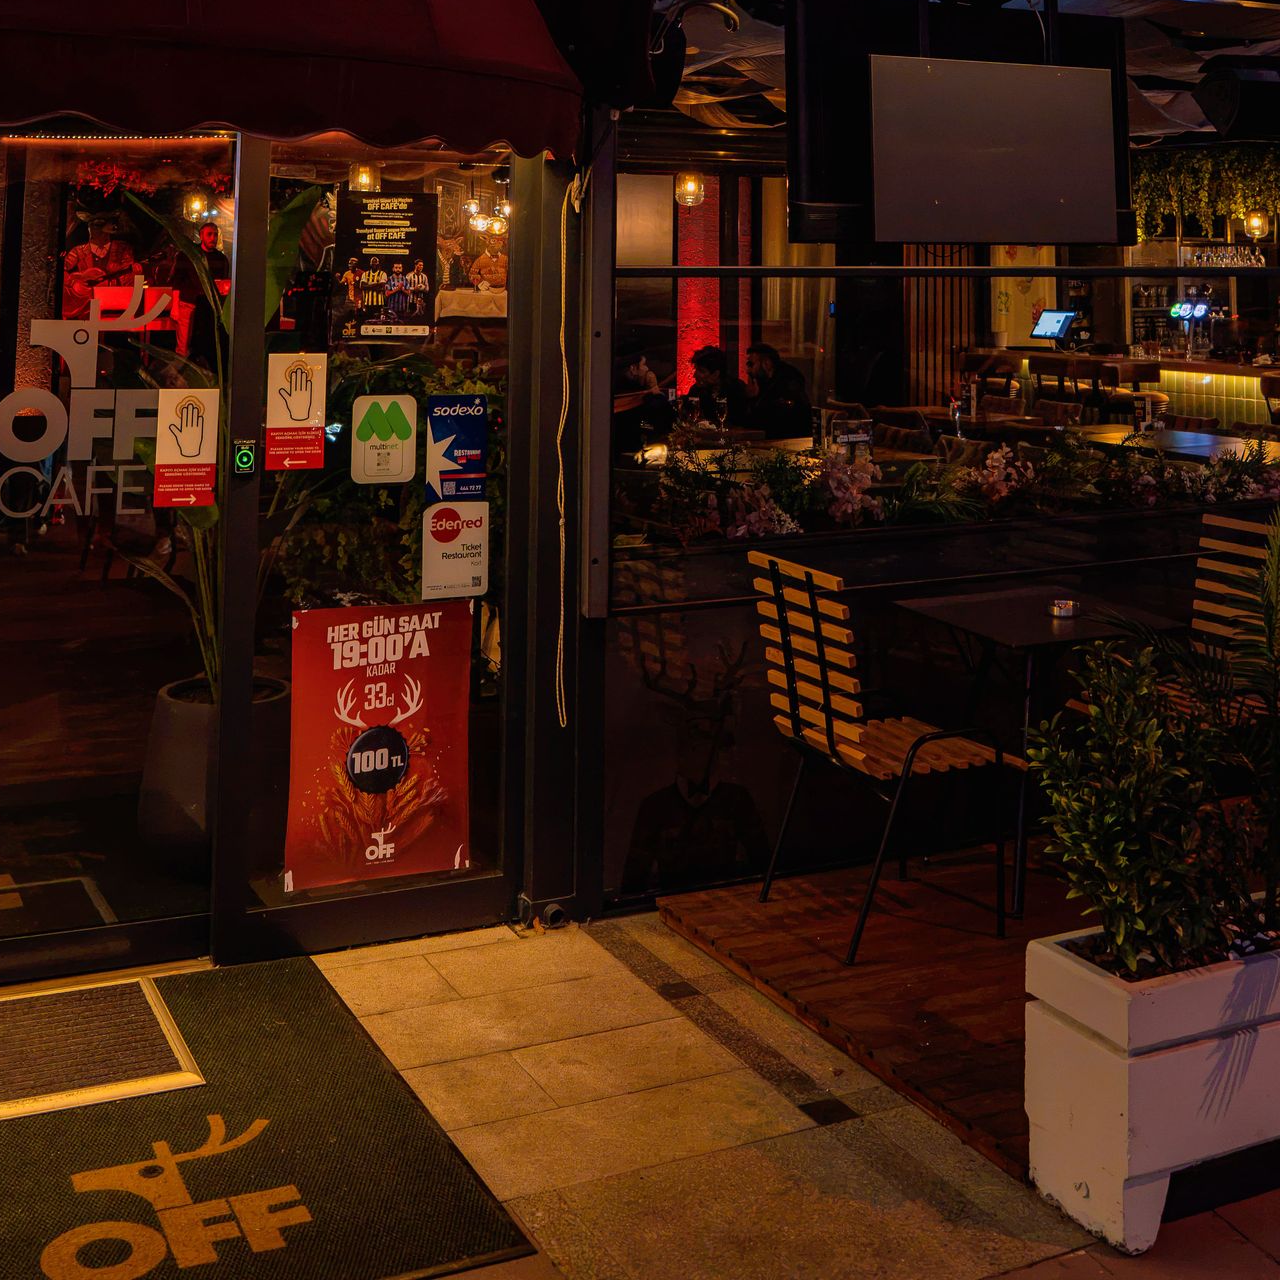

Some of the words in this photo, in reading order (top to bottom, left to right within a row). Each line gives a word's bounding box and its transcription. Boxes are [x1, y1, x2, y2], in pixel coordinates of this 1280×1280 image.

[388, 231, 406, 239] CAFE
[432, 404, 484, 416] sodexo
[369, 443, 399, 451] multinet
[430, 517, 483, 531] Edenred
[461, 543, 482, 551] Ticket
[442, 551, 482, 560] Restaurant
[327, 622, 359, 644] HER
[362, 615, 396, 638] GÜN
[399, 612, 442, 631] SAAT
[366, 662, 396, 677] KADAR
[351, 748, 389, 774] 100
[391, 756, 404, 767] TL
[365, 843, 395, 860] OFF
[40, 1184, 313, 1280] OFF
